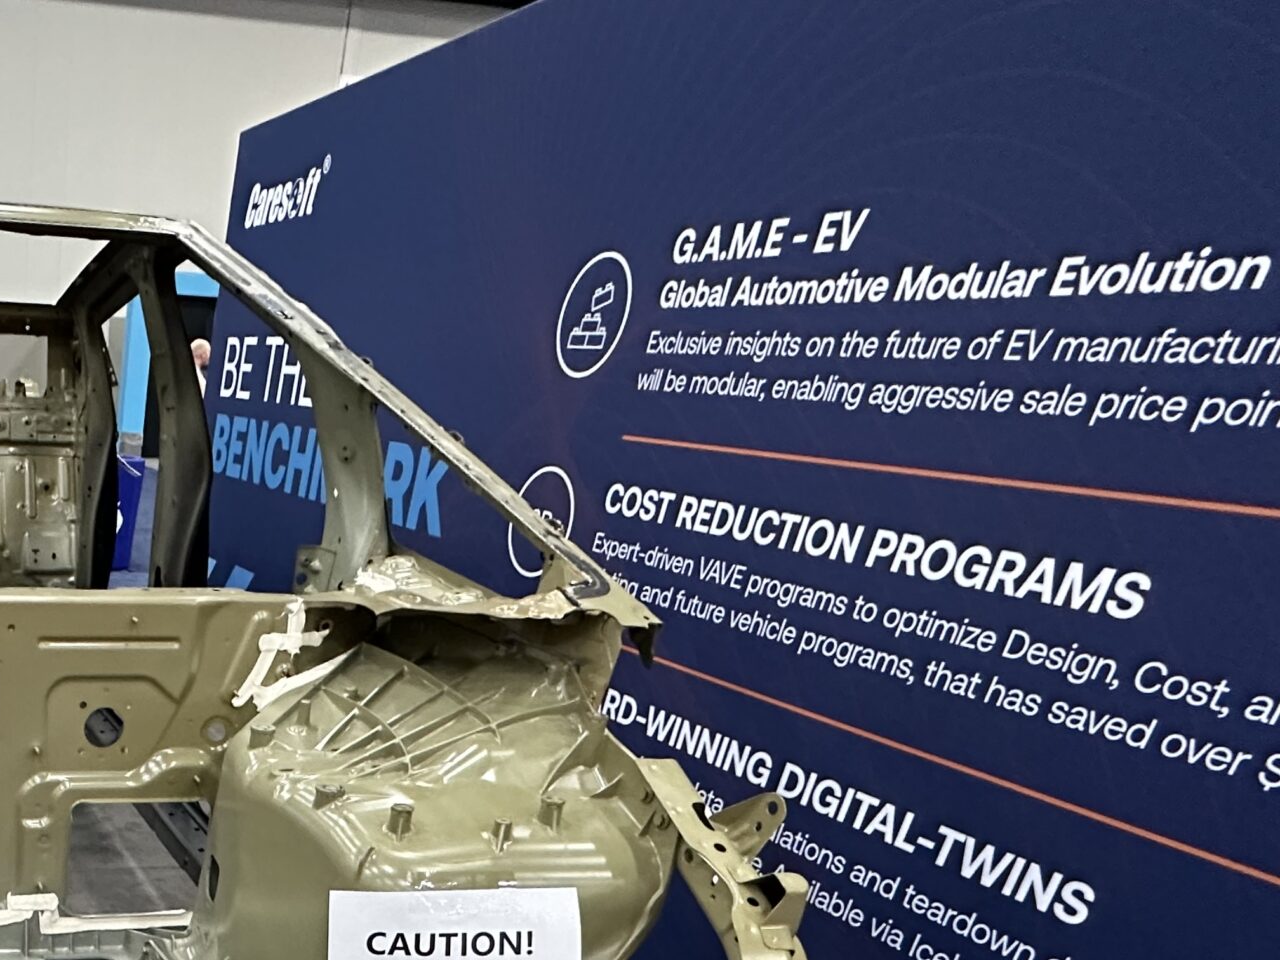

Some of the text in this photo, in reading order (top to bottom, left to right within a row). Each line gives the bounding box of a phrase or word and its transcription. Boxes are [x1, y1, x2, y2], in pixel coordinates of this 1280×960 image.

[672, 217, 791, 265] G.A.M.E
[812, 208, 871, 254] EV
[660, 246, 1272, 310] Global Automotive Modular Evolution
[220, 336, 258, 400] BE
[645, 327, 1280, 365] Exclusive insights on the future of EV manufacturi
[636, 368, 664, 391] will
[663, 369, 687, 393] be
[688, 370, 767, 402] modular,
[771, 374, 865, 411] enabling
[868, 380, 1014, 415] aggressive
[1019, 383, 1087, 417] sale
[1088, 386, 1188, 427] price
[212, 413, 450, 539] BENCHRK
[604, 483, 1152, 620] COST REDUCTION PROGRAMS
[591, 531, 695, 577] Expert-driven
[699, 555, 747, 590] VAVE
[744, 573, 848, 616] programs
[852, 594, 878, 623] to
[882, 607, 997, 653] optimize
[1001, 628, 1120, 691] Design,
[1134, 660, 1231, 718] Cost,
[640, 586, 674, 609] and
[673, 589, 726, 624] future
[729, 610, 797, 645] vehicle
[796, 629, 915, 686] programs,
[923, 661, 982, 699] that
[983, 675, 1042, 717] has
[1047, 700, 1158, 750] saved
[1161, 733, 1254, 776] over
[598, 688, 1096, 925] RD-WINNING DIGITAL-TWINS
[769, 823, 846, 875] lations
[849, 864, 901, 901] and
[366, 931, 534, 957] CAUTION!
[871, 917, 905, 951] via
